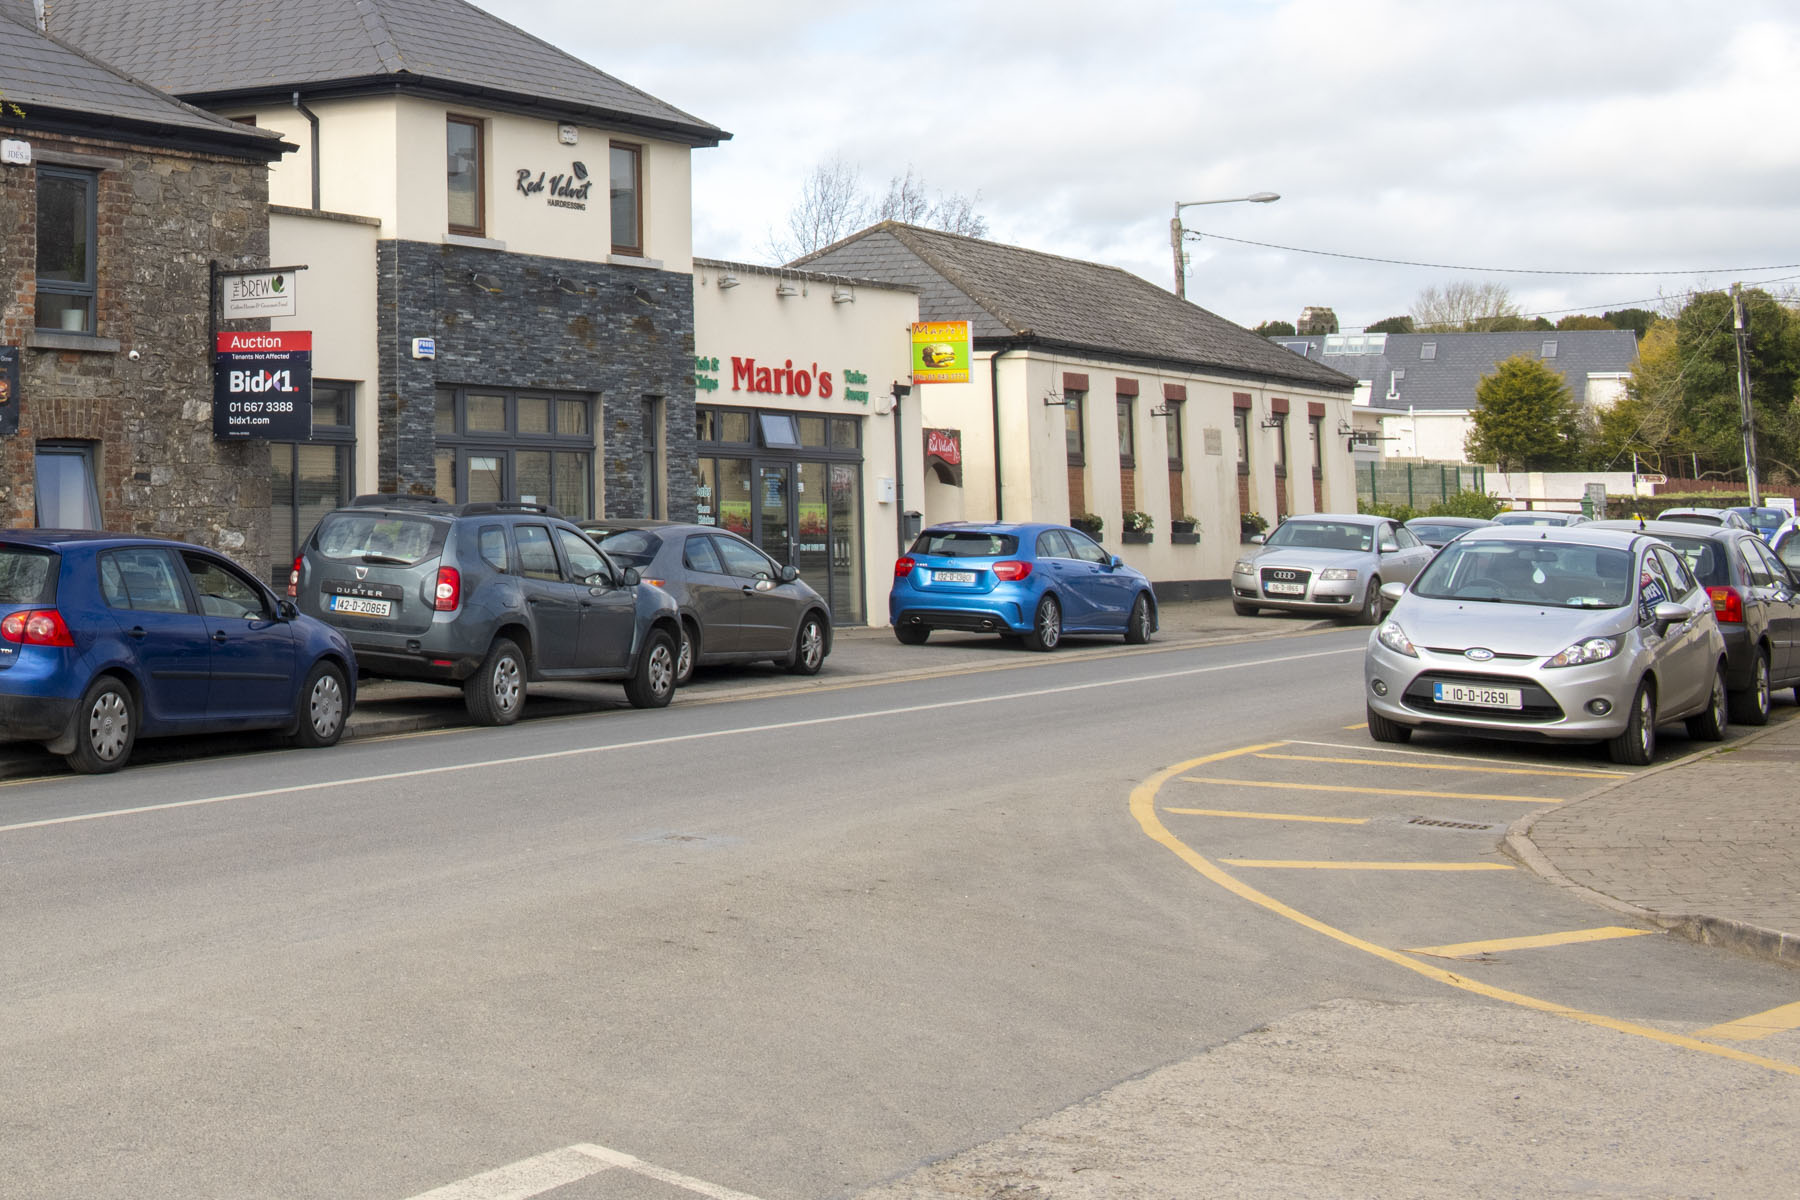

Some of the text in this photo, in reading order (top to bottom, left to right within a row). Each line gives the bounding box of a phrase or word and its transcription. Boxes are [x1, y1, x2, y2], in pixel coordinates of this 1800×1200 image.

[517, 168, 592, 200] Red Velvet
[547, 199, 586, 211] HAIRDRESSING
[241, 279, 271, 298] BREW
[231, 336, 282, 349] Auction
[731, 356, 833, 399] Mario's
[229, 402, 293, 413] 01 667 3388
[229, 416, 270, 425] bidx1.com
[336, 587, 383, 597] DUSTER
[337, 599, 387, 614] 142-D-20865
[1452, 688, 1509, 704] 10-D-12691
